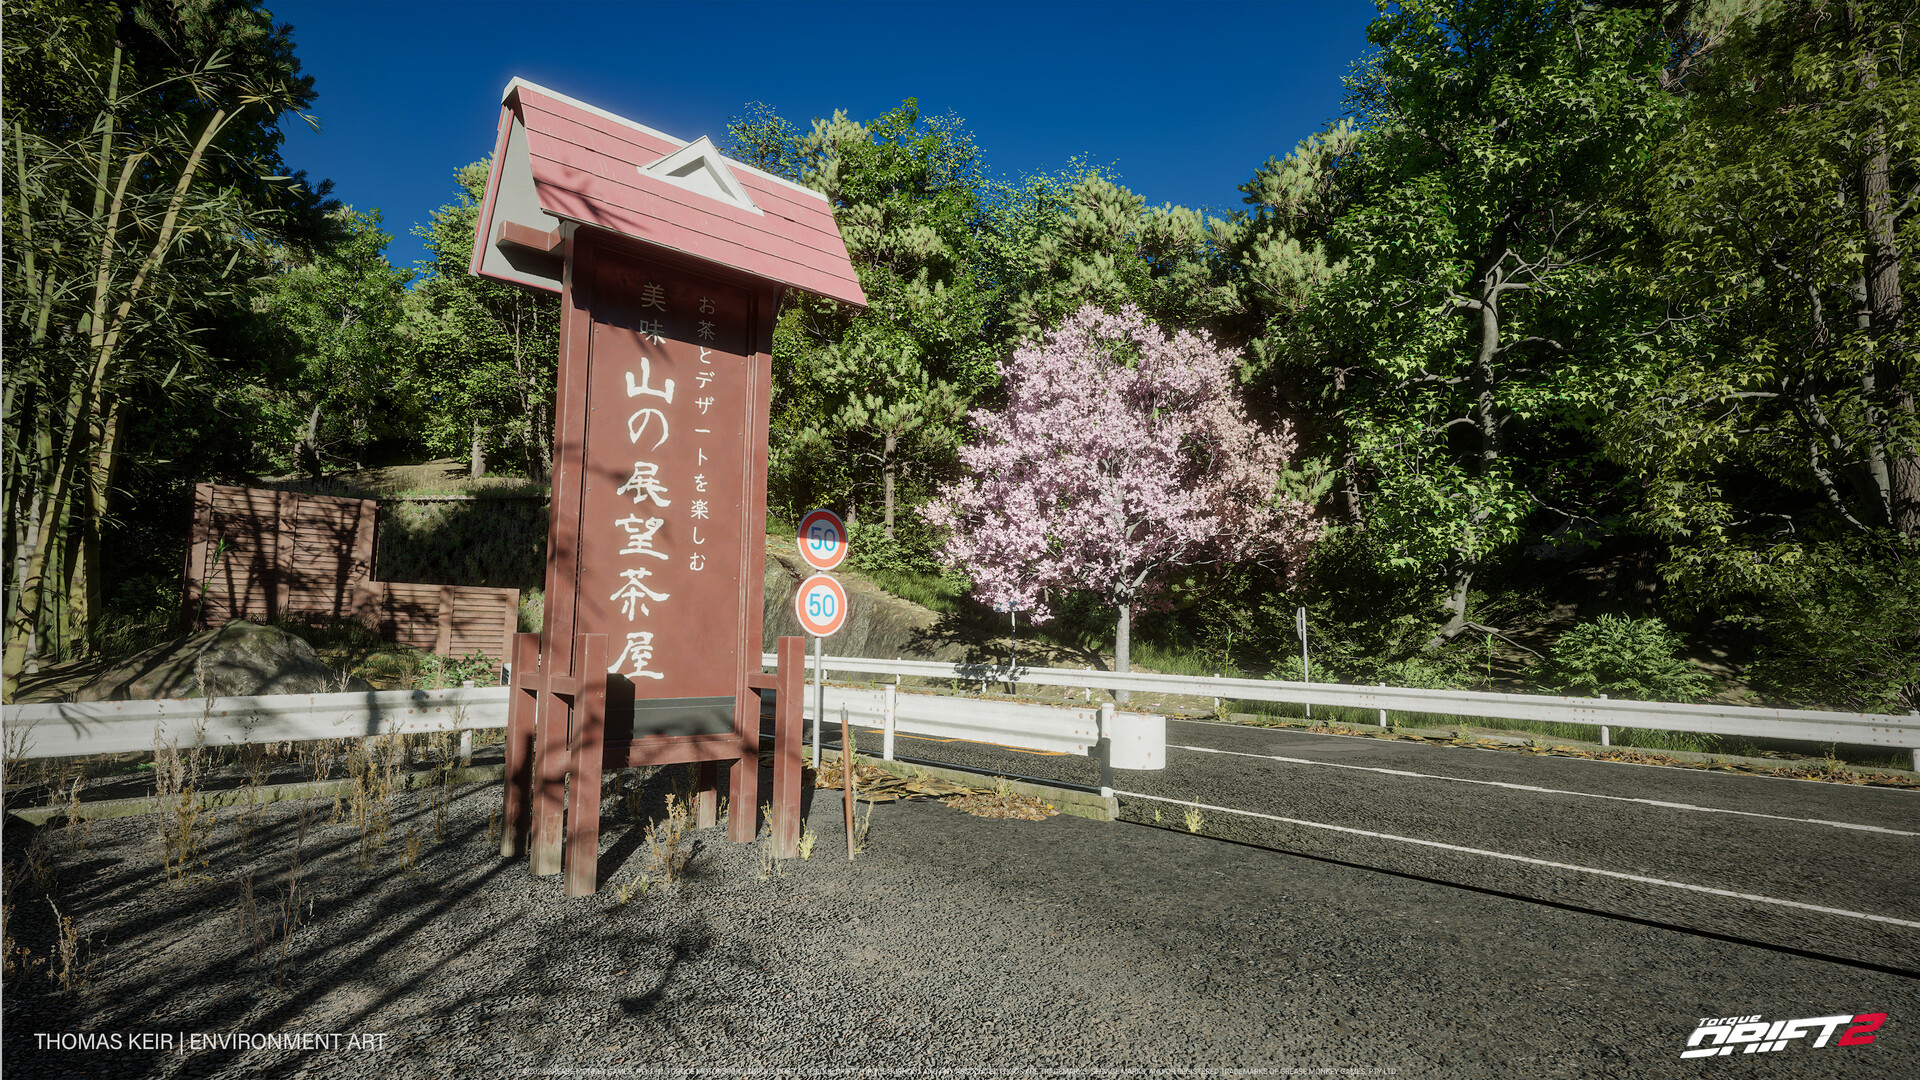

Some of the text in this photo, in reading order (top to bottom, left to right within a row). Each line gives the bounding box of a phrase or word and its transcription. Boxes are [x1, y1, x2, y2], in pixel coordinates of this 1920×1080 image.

[640, 282, 666, 345] 美味
[689, 296, 715, 571] お茶とデザートを楽しむ
[607, 357, 675, 680] 山の展望茶屋
[810, 527, 836, 552] 50
[809, 593, 835, 617] 50
